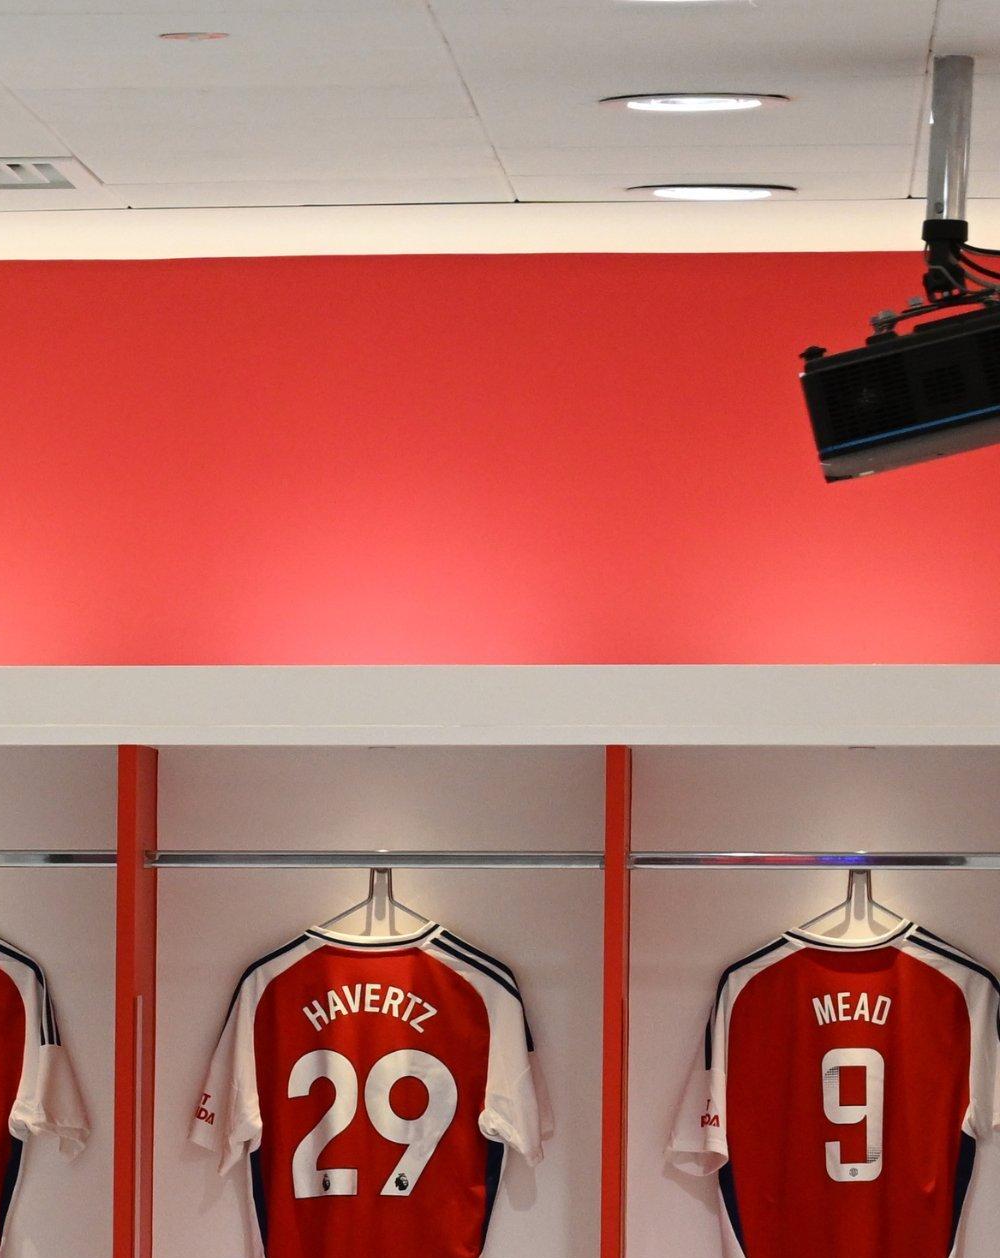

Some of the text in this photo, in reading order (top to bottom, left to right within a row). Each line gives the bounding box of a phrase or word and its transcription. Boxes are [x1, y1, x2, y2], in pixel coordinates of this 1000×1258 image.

[302, 983, 438, 1034] HAVERTZ
[812, 991, 892, 1026] MEAD
[287, 1049, 458, 1199] 29
[821, 1047, 885, 1183] 9
